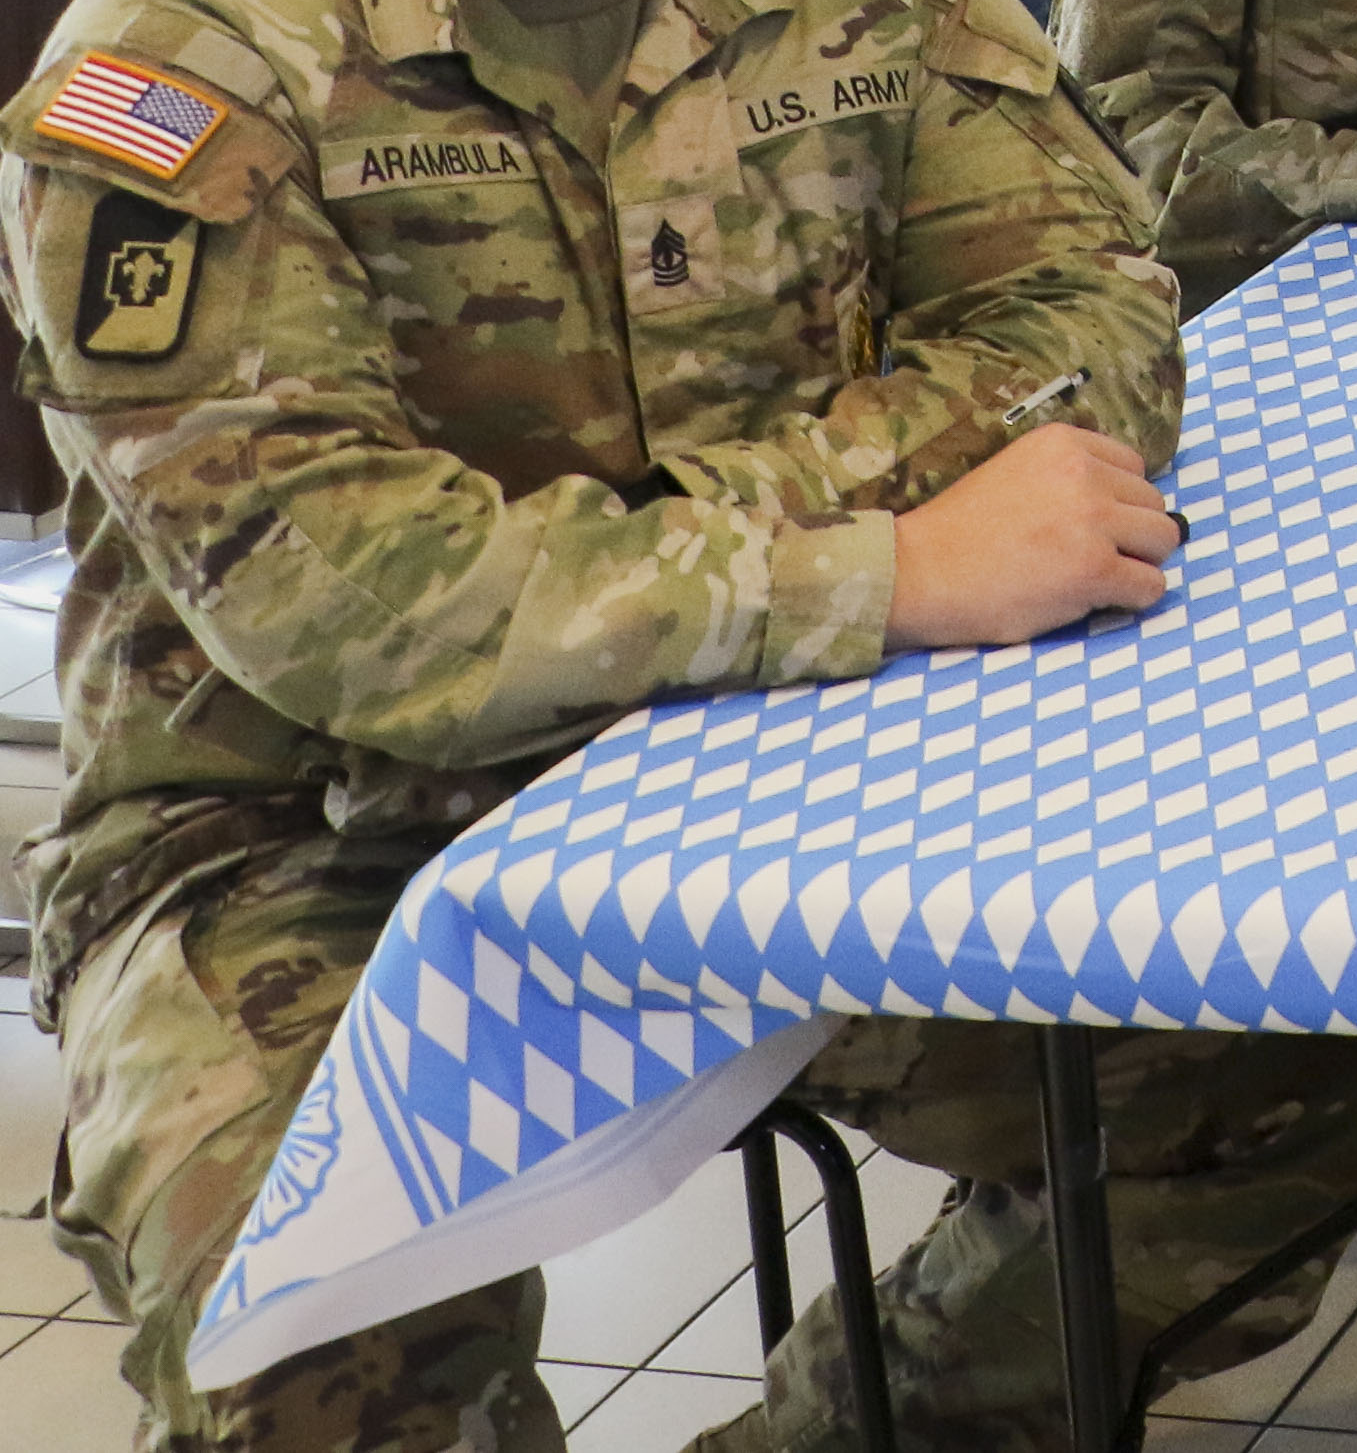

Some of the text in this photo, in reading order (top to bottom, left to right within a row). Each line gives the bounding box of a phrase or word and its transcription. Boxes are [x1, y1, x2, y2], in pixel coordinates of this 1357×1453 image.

[746, 69, 910, 134] U.S. ARMY
[360, 141, 521, 187] ARAMBULA
